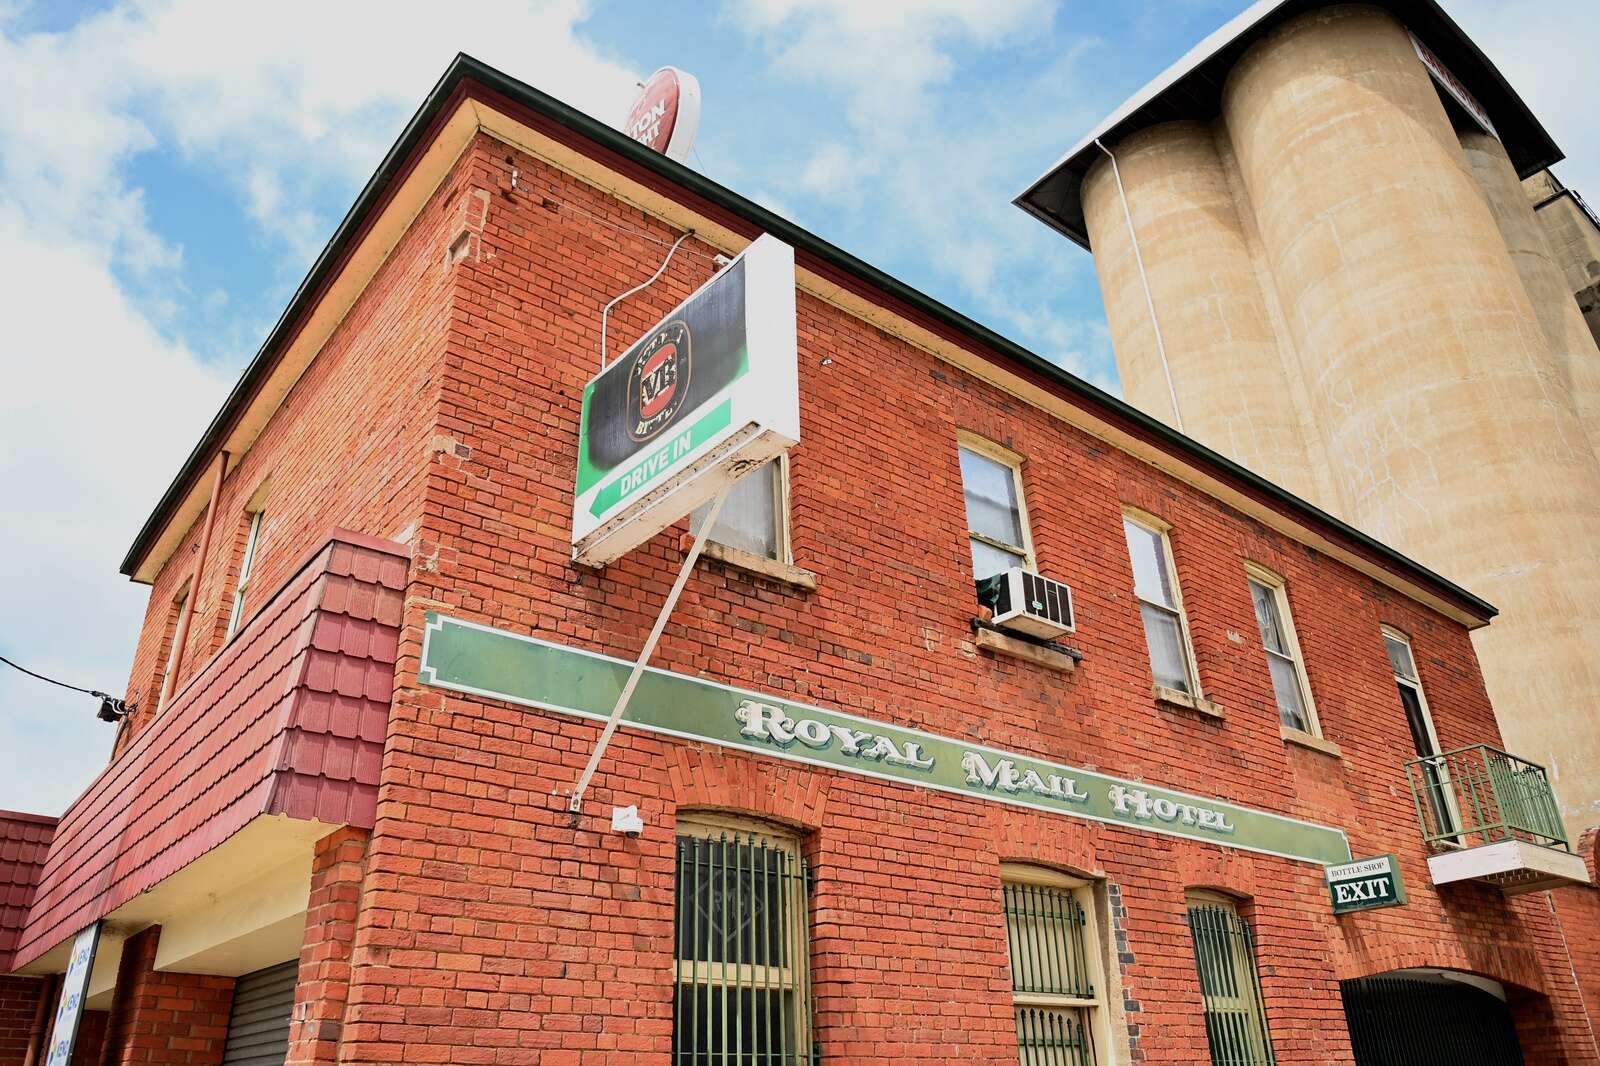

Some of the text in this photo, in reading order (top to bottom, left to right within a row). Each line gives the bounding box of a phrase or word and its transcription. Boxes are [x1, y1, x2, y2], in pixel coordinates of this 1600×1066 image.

[620, 430, 693, 497] DRIVE IN
[734, 699, 1236, 833] ROYAL MAIL HOTEL
[1330, 861, 1385, 878] BOTTLE SHOP
[1333, 876, 1391, 904] EXIT
